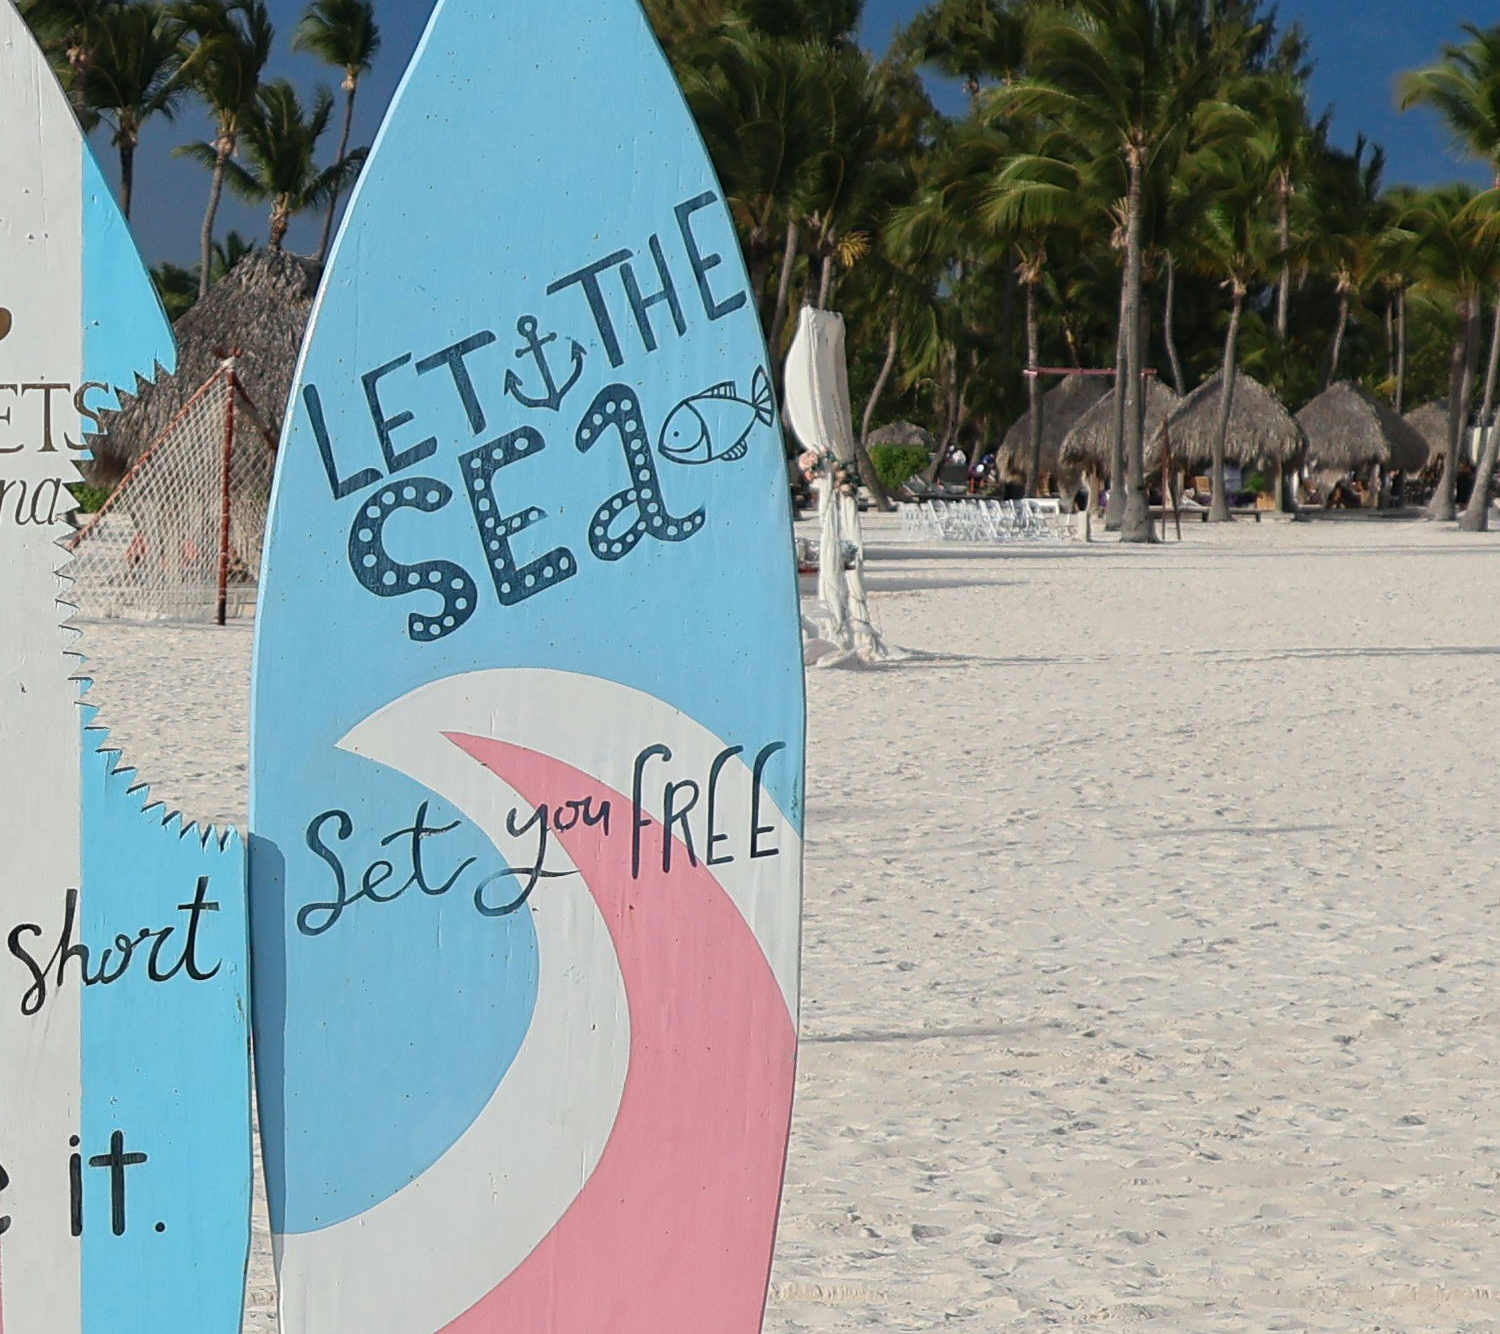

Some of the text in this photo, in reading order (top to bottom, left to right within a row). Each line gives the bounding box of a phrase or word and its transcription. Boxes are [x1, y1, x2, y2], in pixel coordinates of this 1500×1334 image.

[302, 190, 748, 500] LET THE
[296, 740, 787, 937] Set you FREE
[6, 875, 223, 1016] short
[69, 1129, 167, 1238] it.
